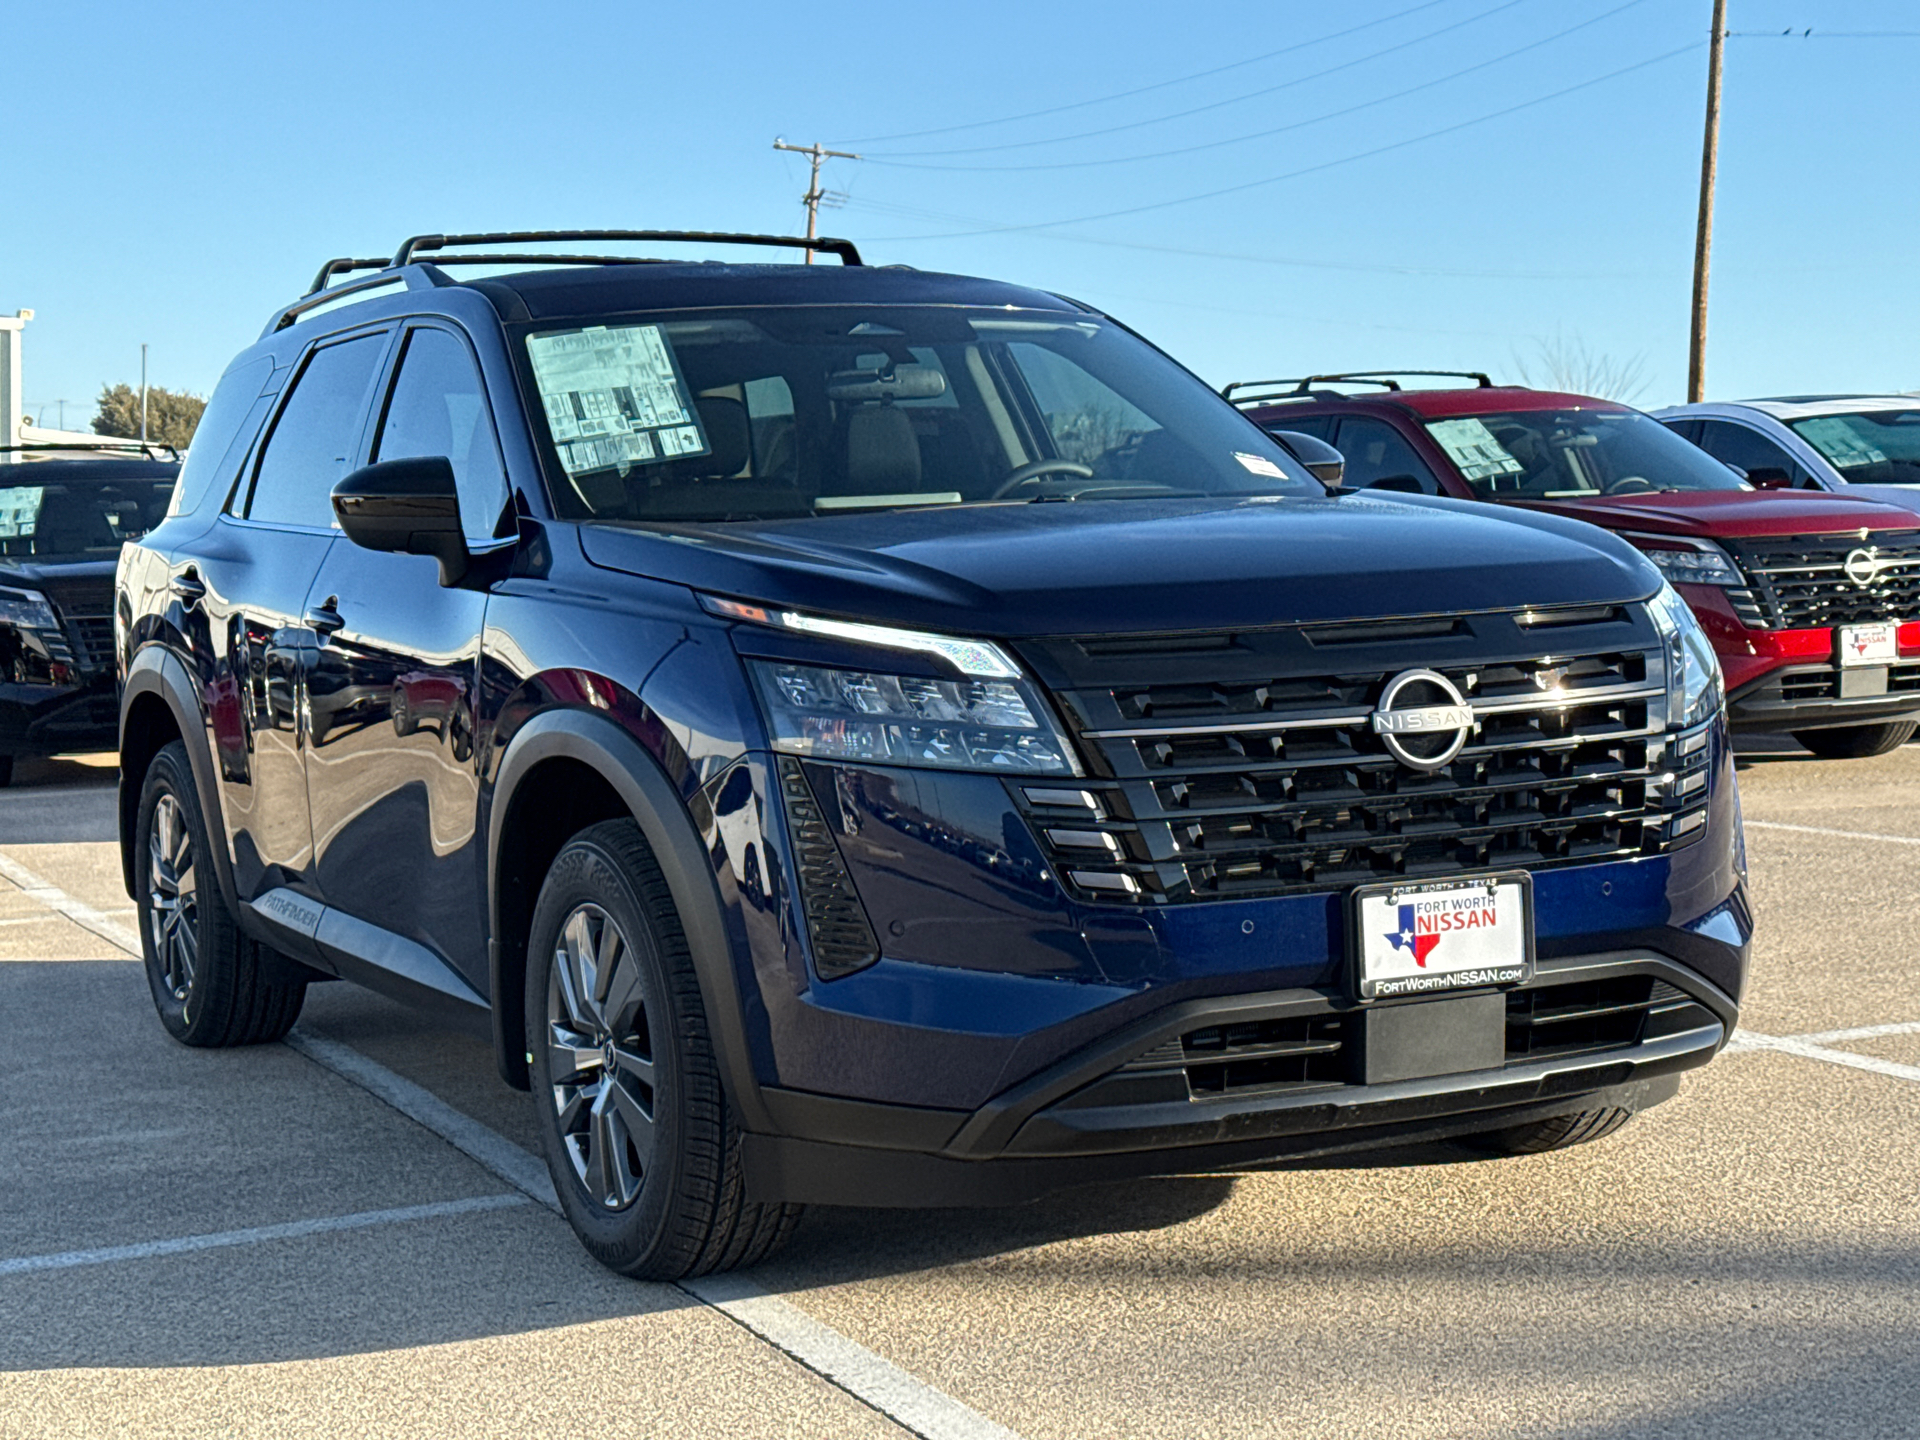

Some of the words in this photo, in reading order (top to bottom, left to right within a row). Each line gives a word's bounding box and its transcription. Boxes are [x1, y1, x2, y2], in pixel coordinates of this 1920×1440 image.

[1376, 710, 1471, 731] NISSAN
[1393, 886, 1417, 896] FORT
[1421, 882, 1454, 893] WORTH
[1468, 878, 1498, 888] TEXAS
[264, 893, 319, 929] PATHFINDER
[1417, 900, 1448, 914] FORT
[1451, 896, 1496, 910] WORTH
[1418, 908, 1497, 934] NISSAN
